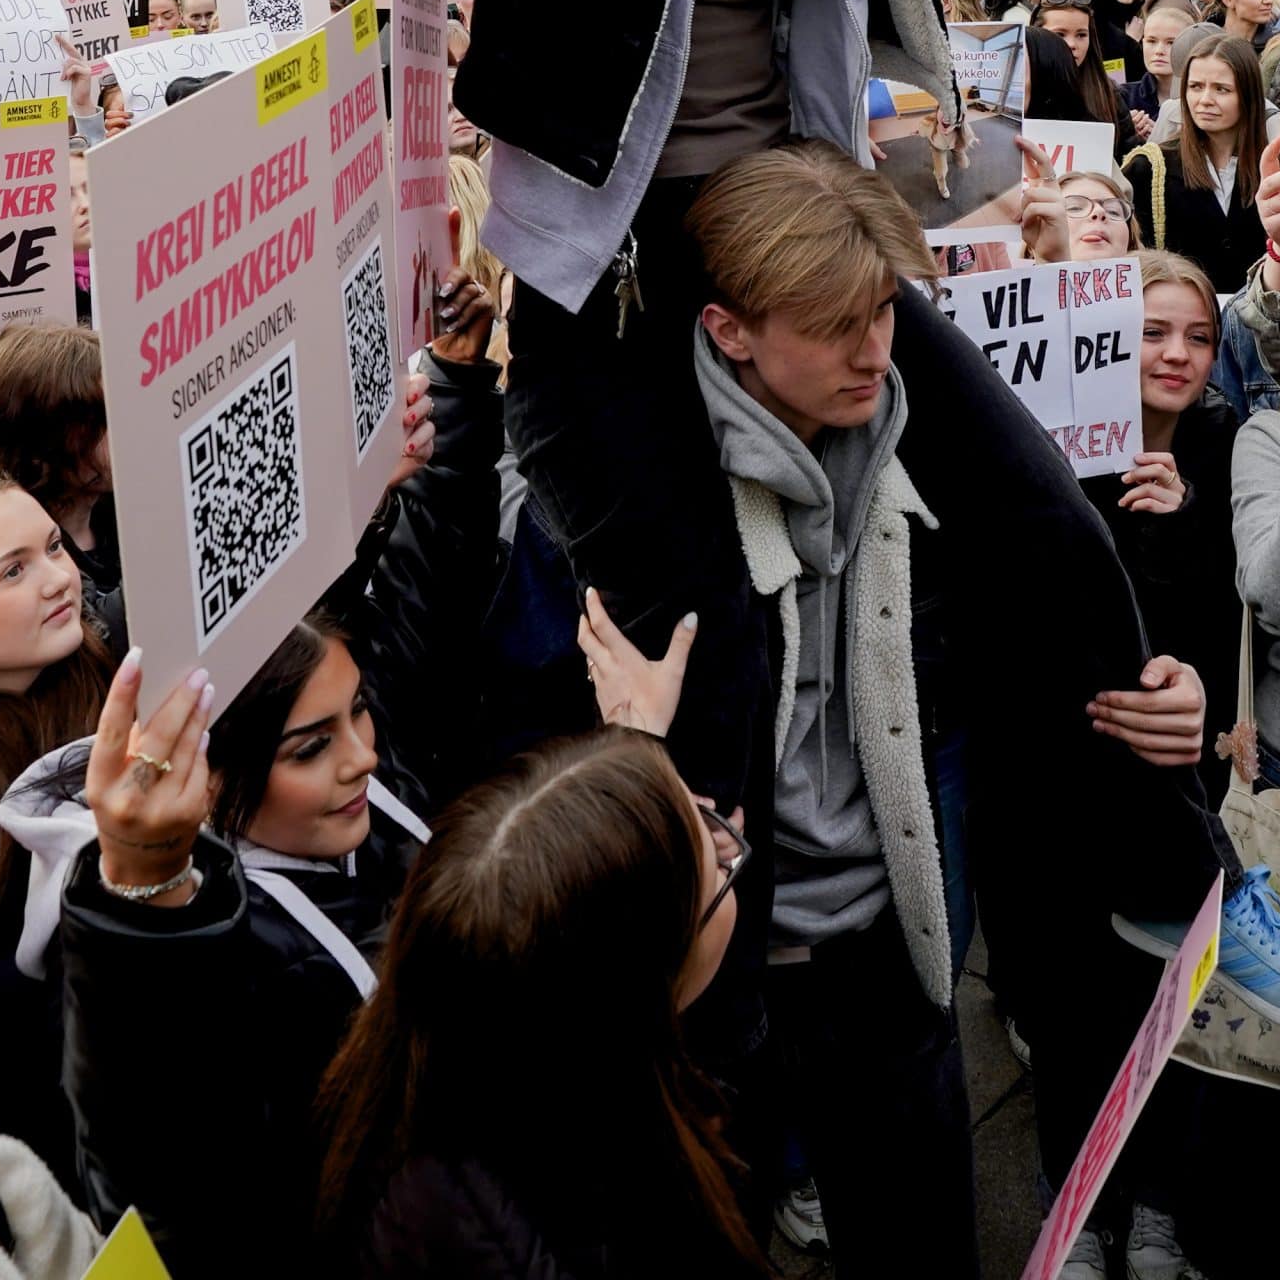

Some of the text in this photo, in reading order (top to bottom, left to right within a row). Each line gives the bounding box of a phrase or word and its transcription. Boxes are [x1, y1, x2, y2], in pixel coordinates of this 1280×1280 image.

[115, 32, 275, 80] DEN SOM TIER
[264, 56, 301, 93] AMNESTY
[964, 51, 999, 61] kunne
[7, 105, 42, 116] AMNESTY
[264, 80, 301, 109] INTERNATIONAL
[343, 72, 378, 143] EN REELL
[402, 66, 444, 161] REELL
[4, 147, 56, 179] TIER
[135, 136, 309, 303] KREV EN REELL
[139, 206, 317, 388] SAMTYKKELOV
[171, 299, 297, 419] SIGNER AKSJONEN:
[1074, 331, 1131, 374] DEL
